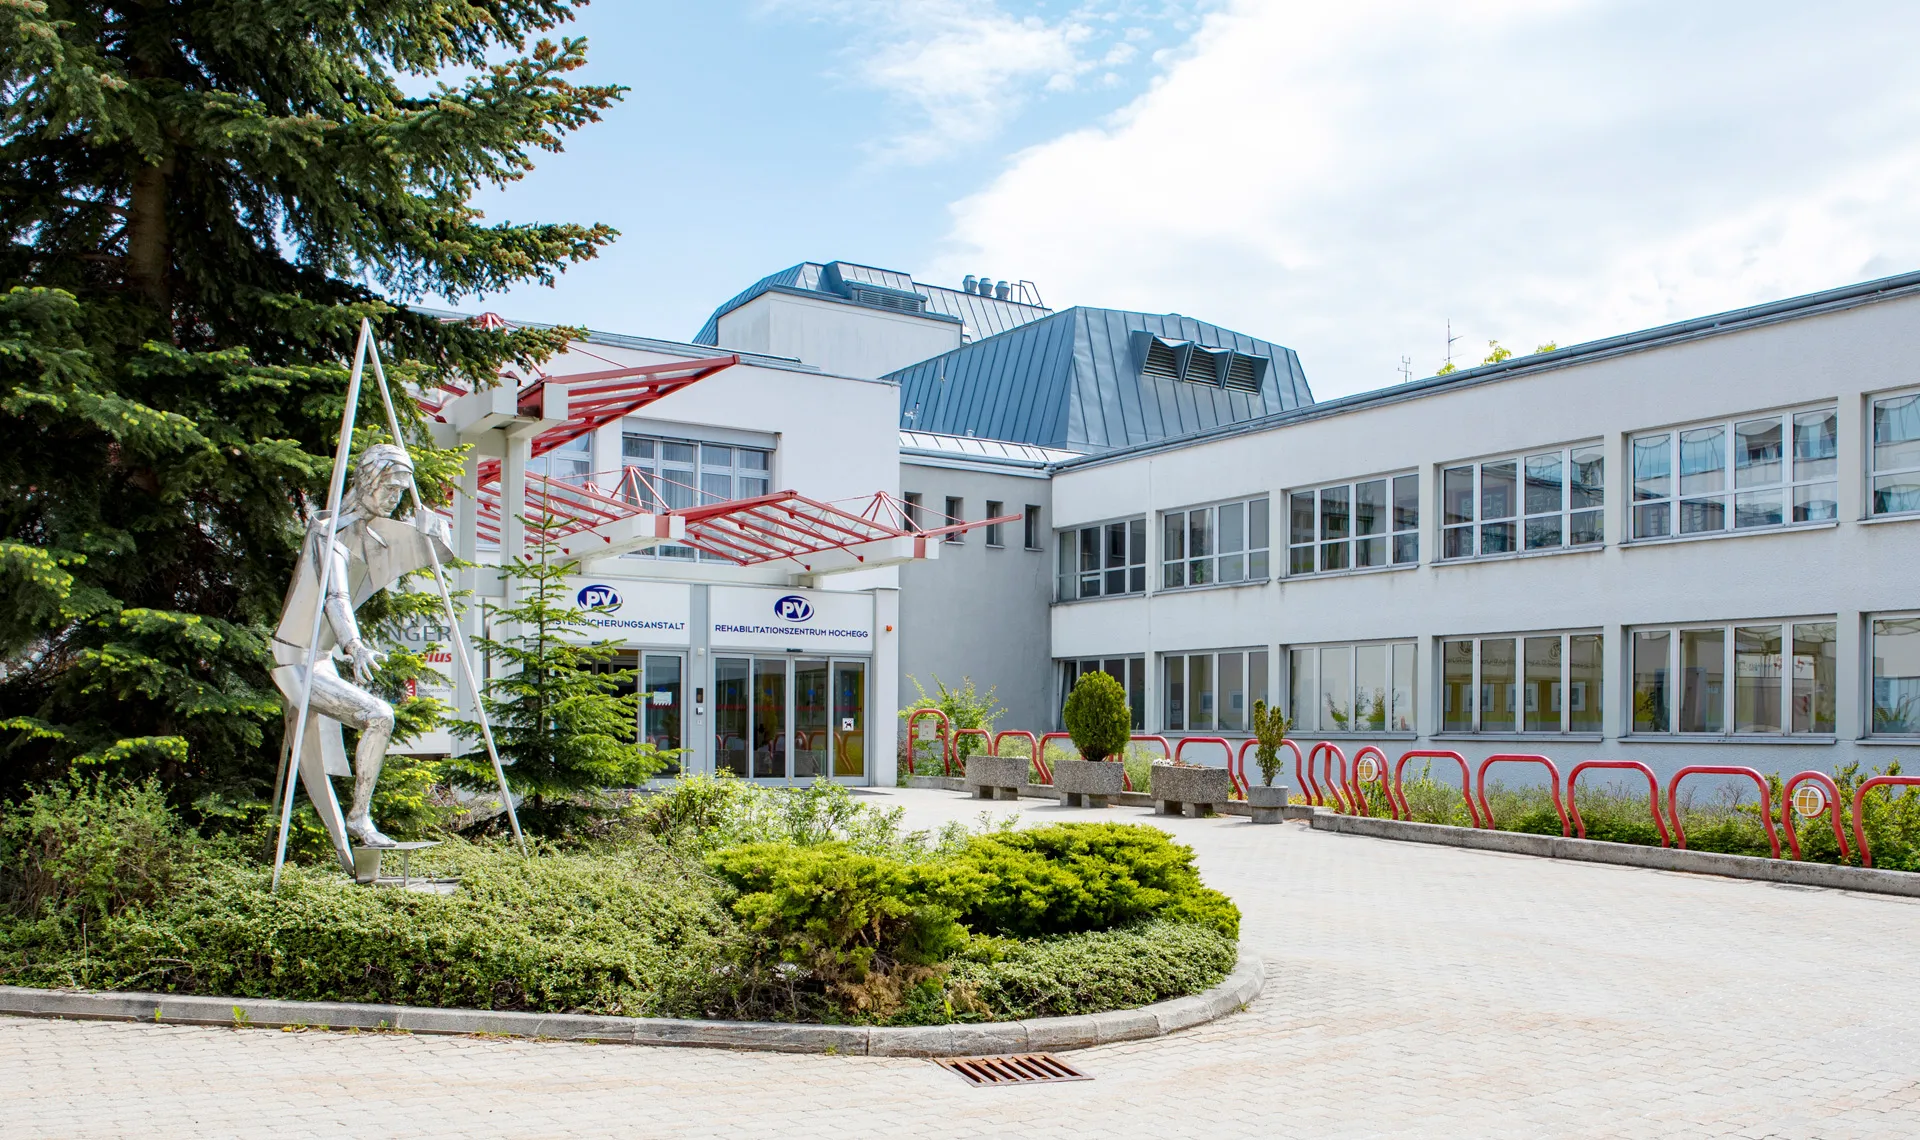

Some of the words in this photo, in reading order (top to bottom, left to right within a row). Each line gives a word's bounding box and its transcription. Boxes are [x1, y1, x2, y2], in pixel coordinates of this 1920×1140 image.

[548, 617, 685, 630] SESICHERUNGSANSTALT
[715, 624, 827, 636] REHABILITATIONSZENTRUM
[828, 629, 869, 638] HOCHEGG
